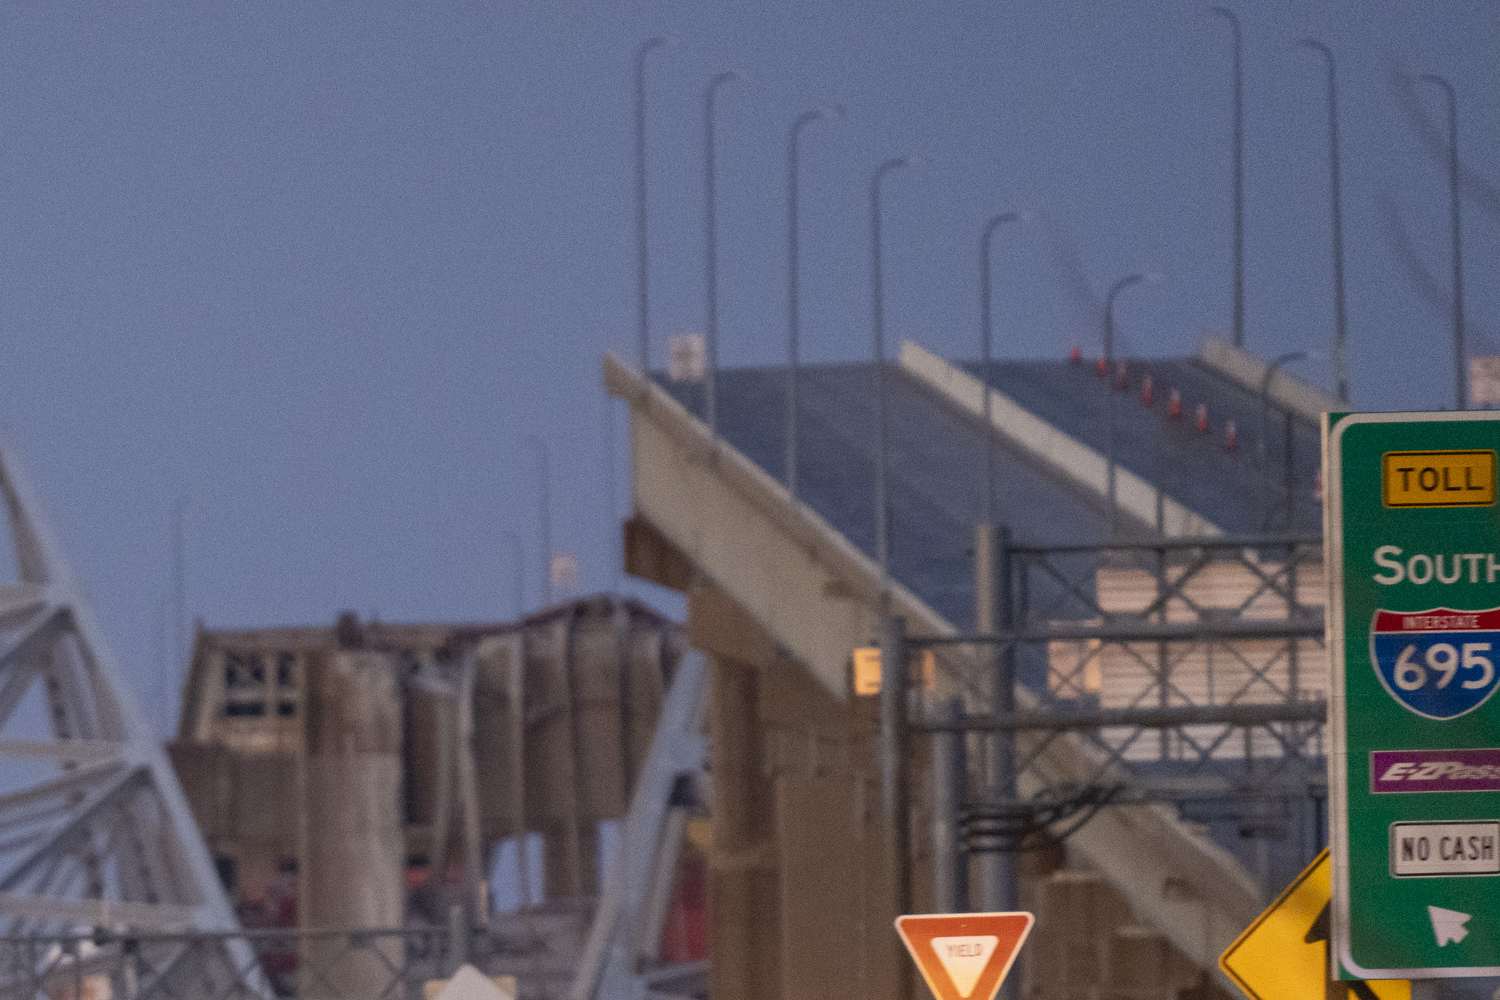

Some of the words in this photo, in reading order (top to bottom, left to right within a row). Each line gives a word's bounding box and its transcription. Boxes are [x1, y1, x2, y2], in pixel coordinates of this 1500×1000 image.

[1396, 466, 1485, 492] TOLL
[1402, 614, 1481, 630] INTERSTATE
[1393, 642, 1496, 691] 695
[1402, 836, 1431, 861] NO
[1439, 835, 1494, 861] CASH
[946, 943, 983, 958] YIELD
